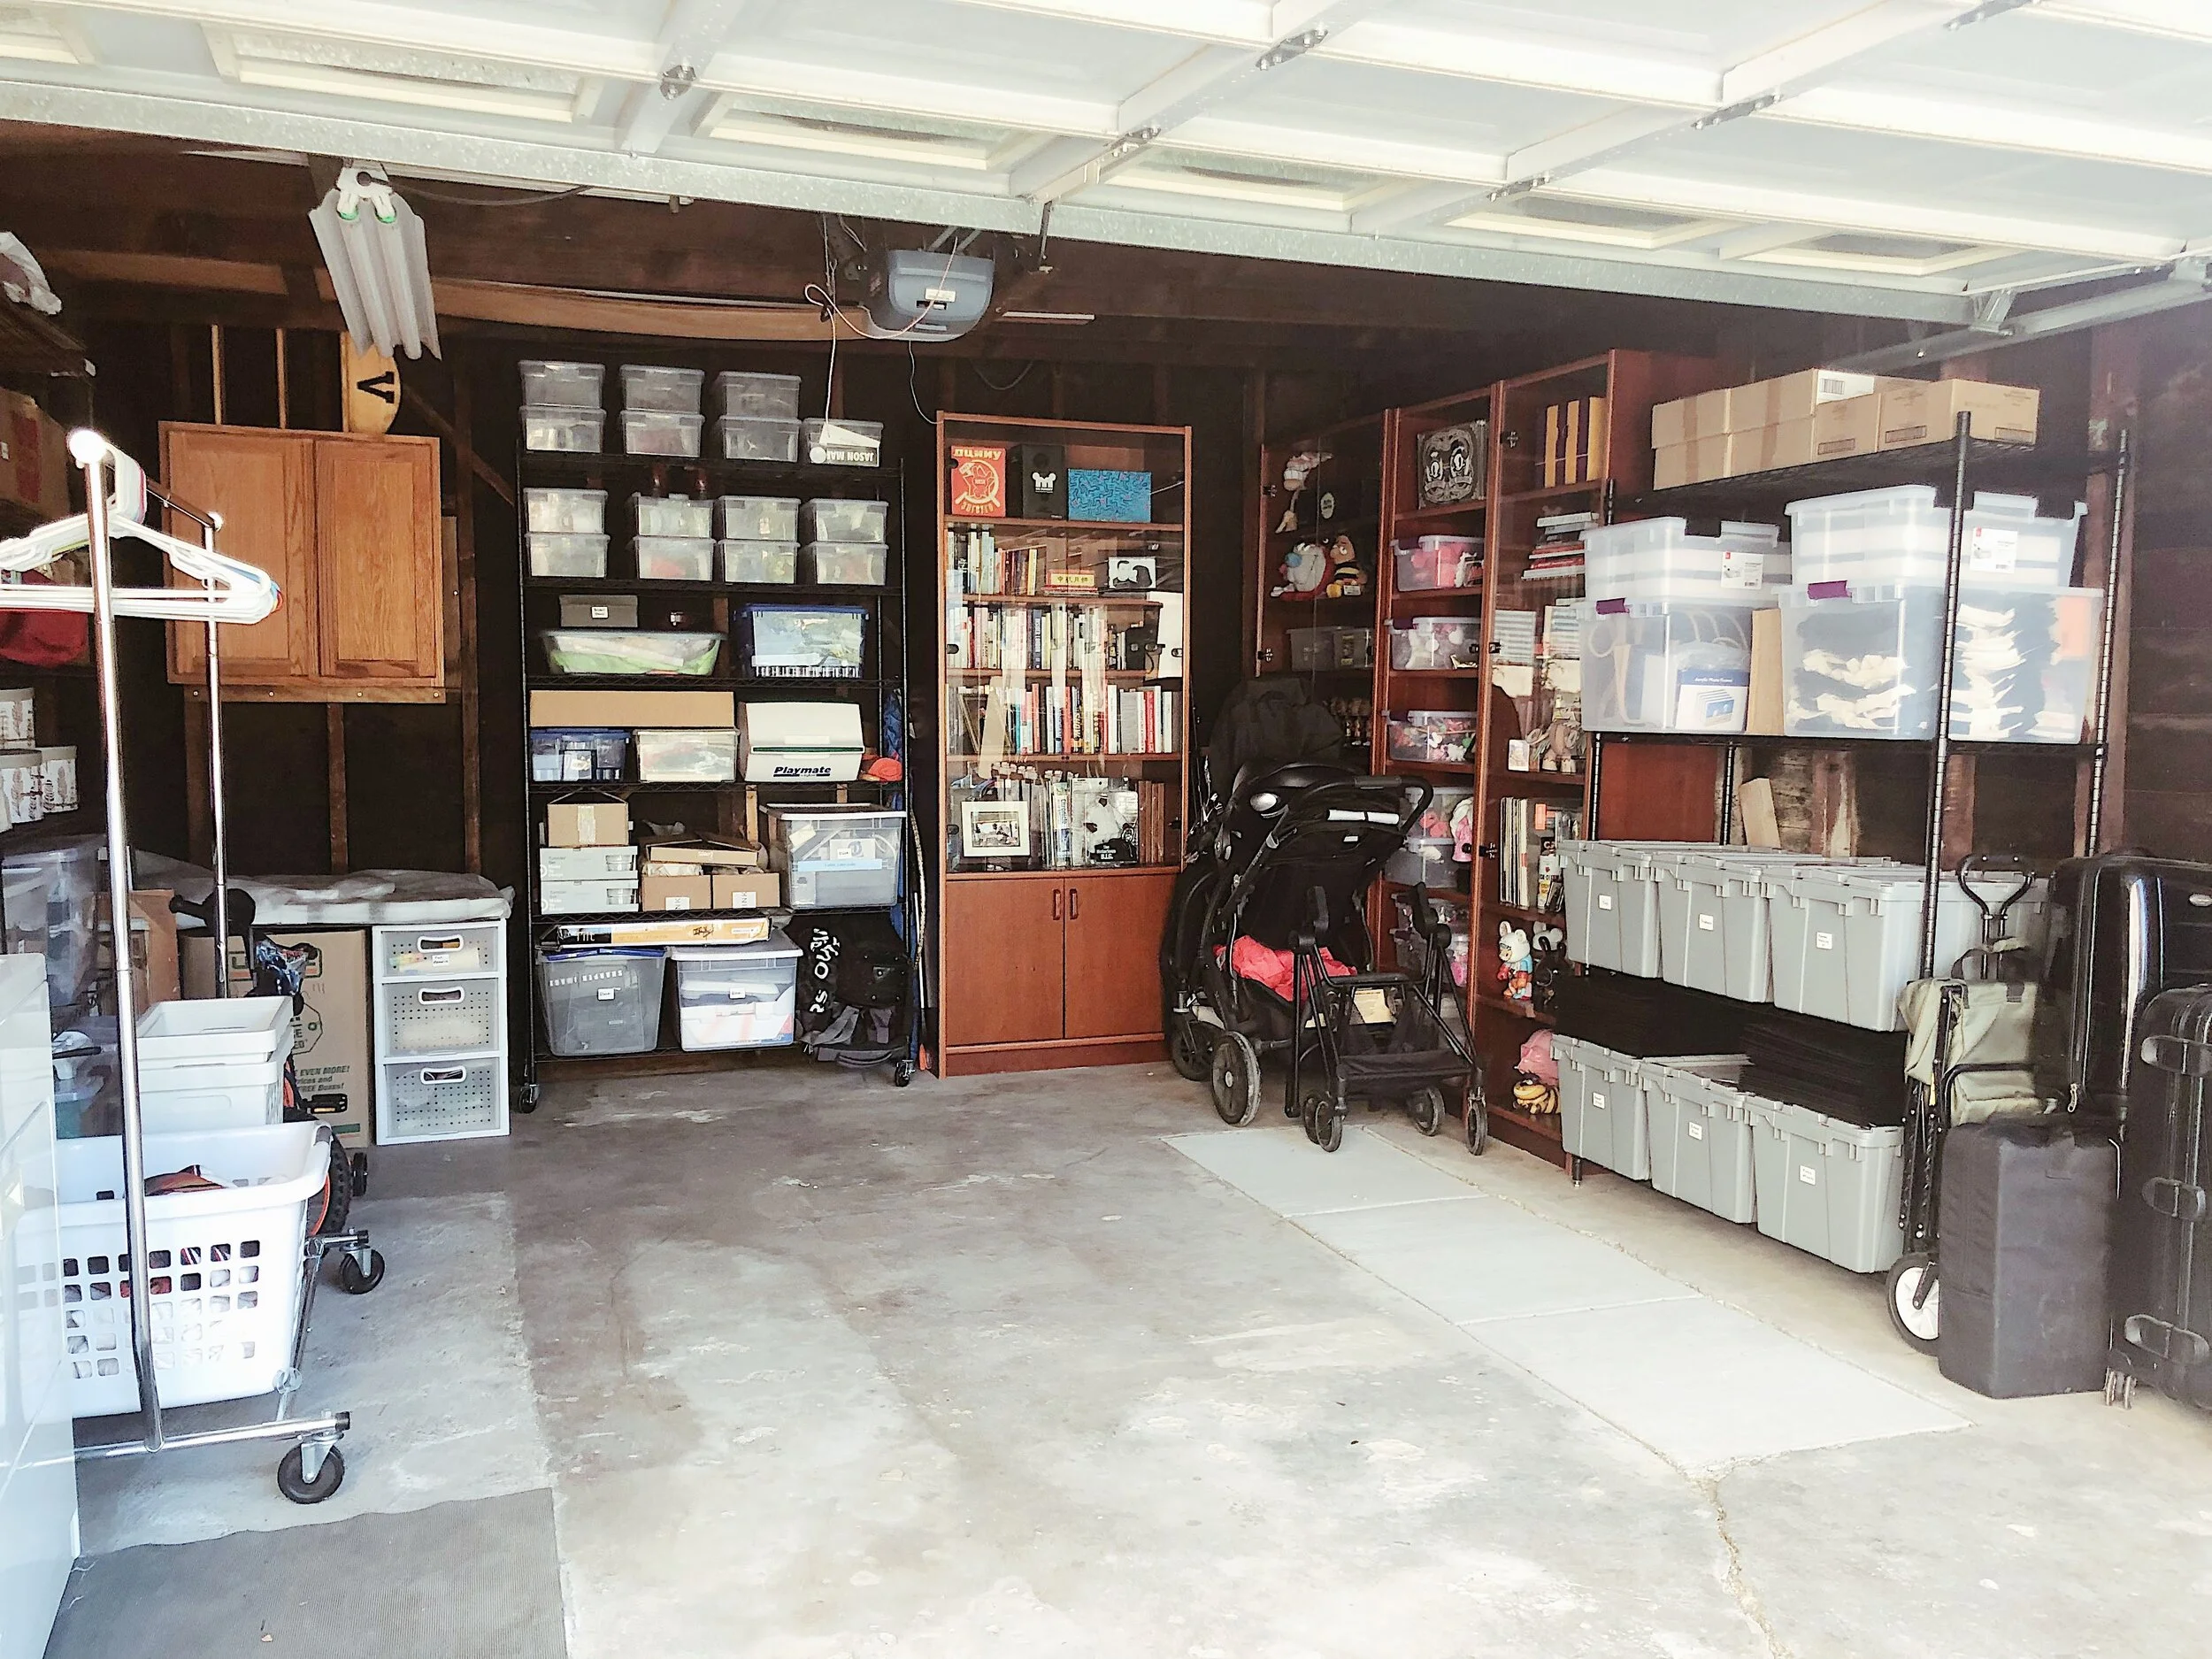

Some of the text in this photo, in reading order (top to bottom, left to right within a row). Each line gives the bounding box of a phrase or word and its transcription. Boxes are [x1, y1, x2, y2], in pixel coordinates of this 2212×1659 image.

[847, 451, 874, 462] JASON
[773, 766, 832, 775] Playmate
[323, 1065, 350, 1075] MORE!
